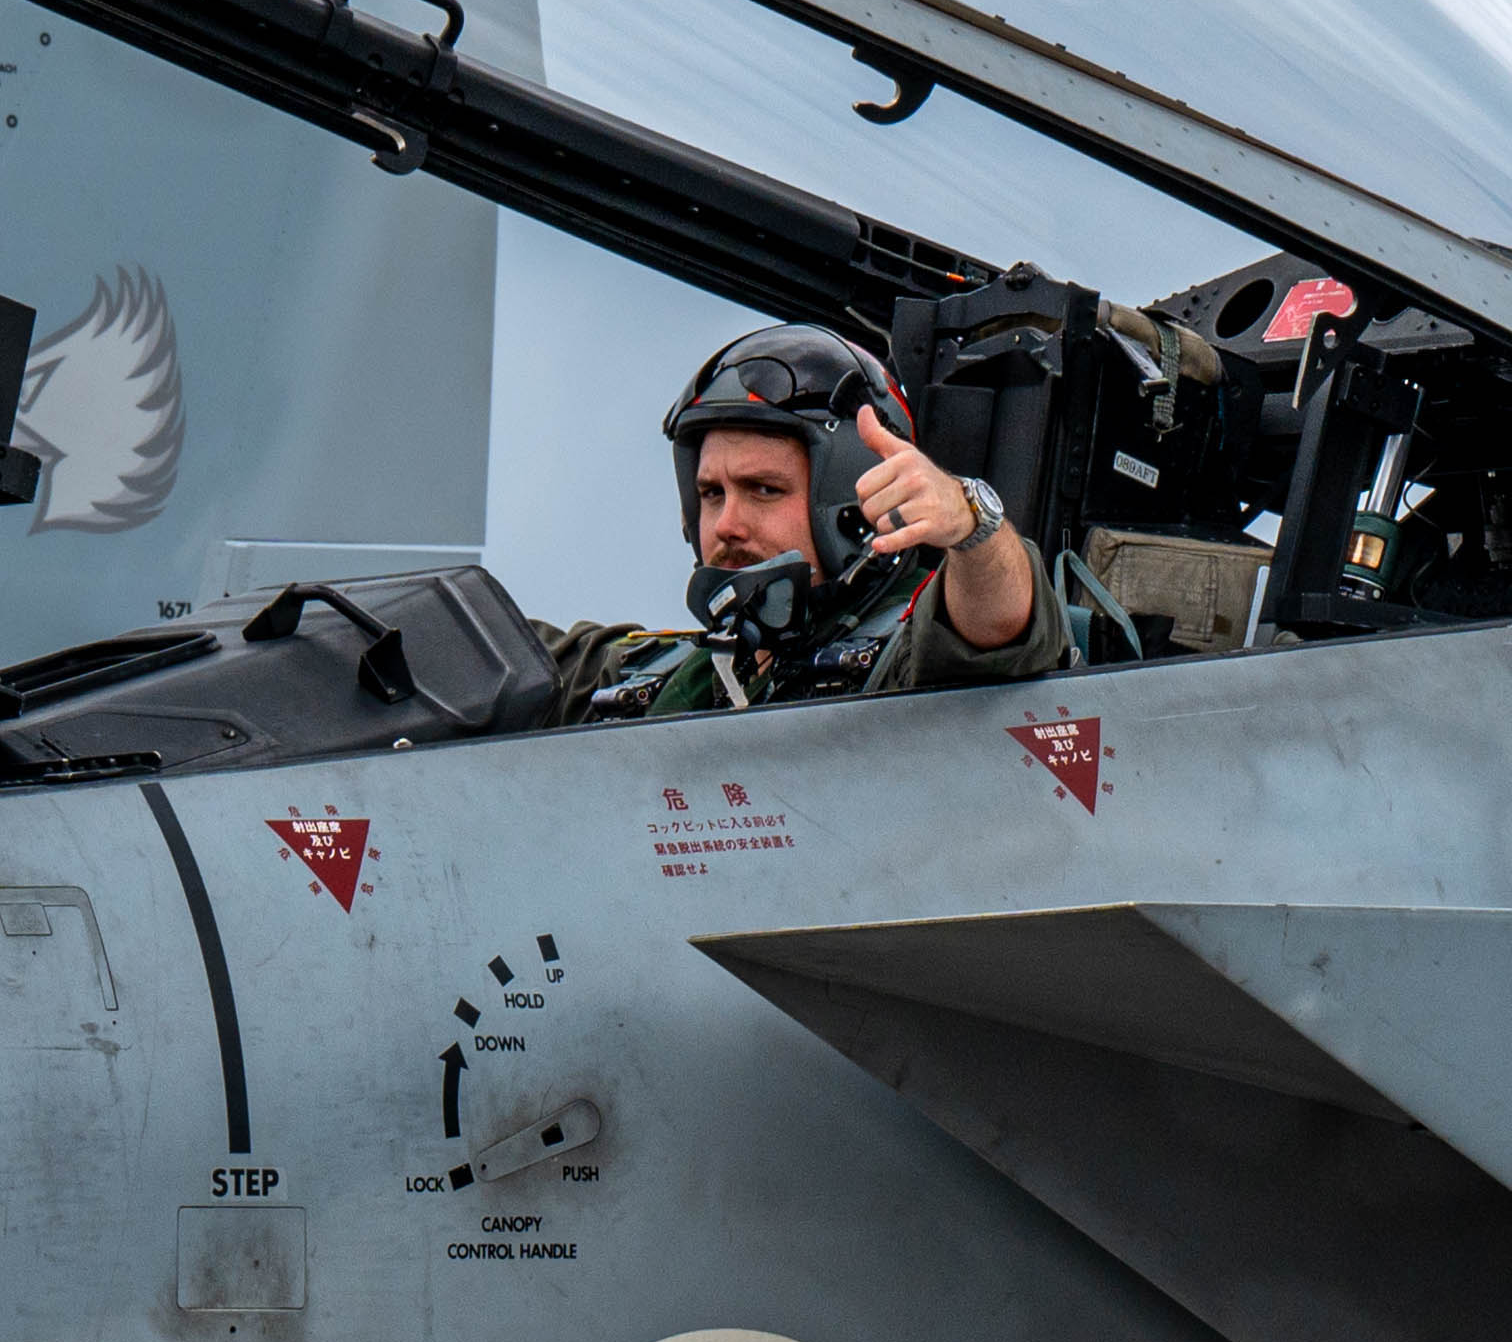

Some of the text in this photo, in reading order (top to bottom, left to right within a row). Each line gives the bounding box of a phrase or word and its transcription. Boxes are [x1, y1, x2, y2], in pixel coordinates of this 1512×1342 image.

[1116, 455, 1159, 485] 089AFT
[662, 782, 752, 812] 危険
[311, 834, 334, 847] 及び
[545, 968, 565, 984] UP
[504, 992, 545, 1010] HOLD
[475, 1035, 526, 1052] DOWN
[562, 1165, 600, 1183] PUSH
[211, 1168, 280, 1198] STEP
[406, 1176, 445, 1192] LOCK
[481, 1216, 543, 1233] CANOPY
[447, 1243, 577, 1260] CONTROL HANDLE
